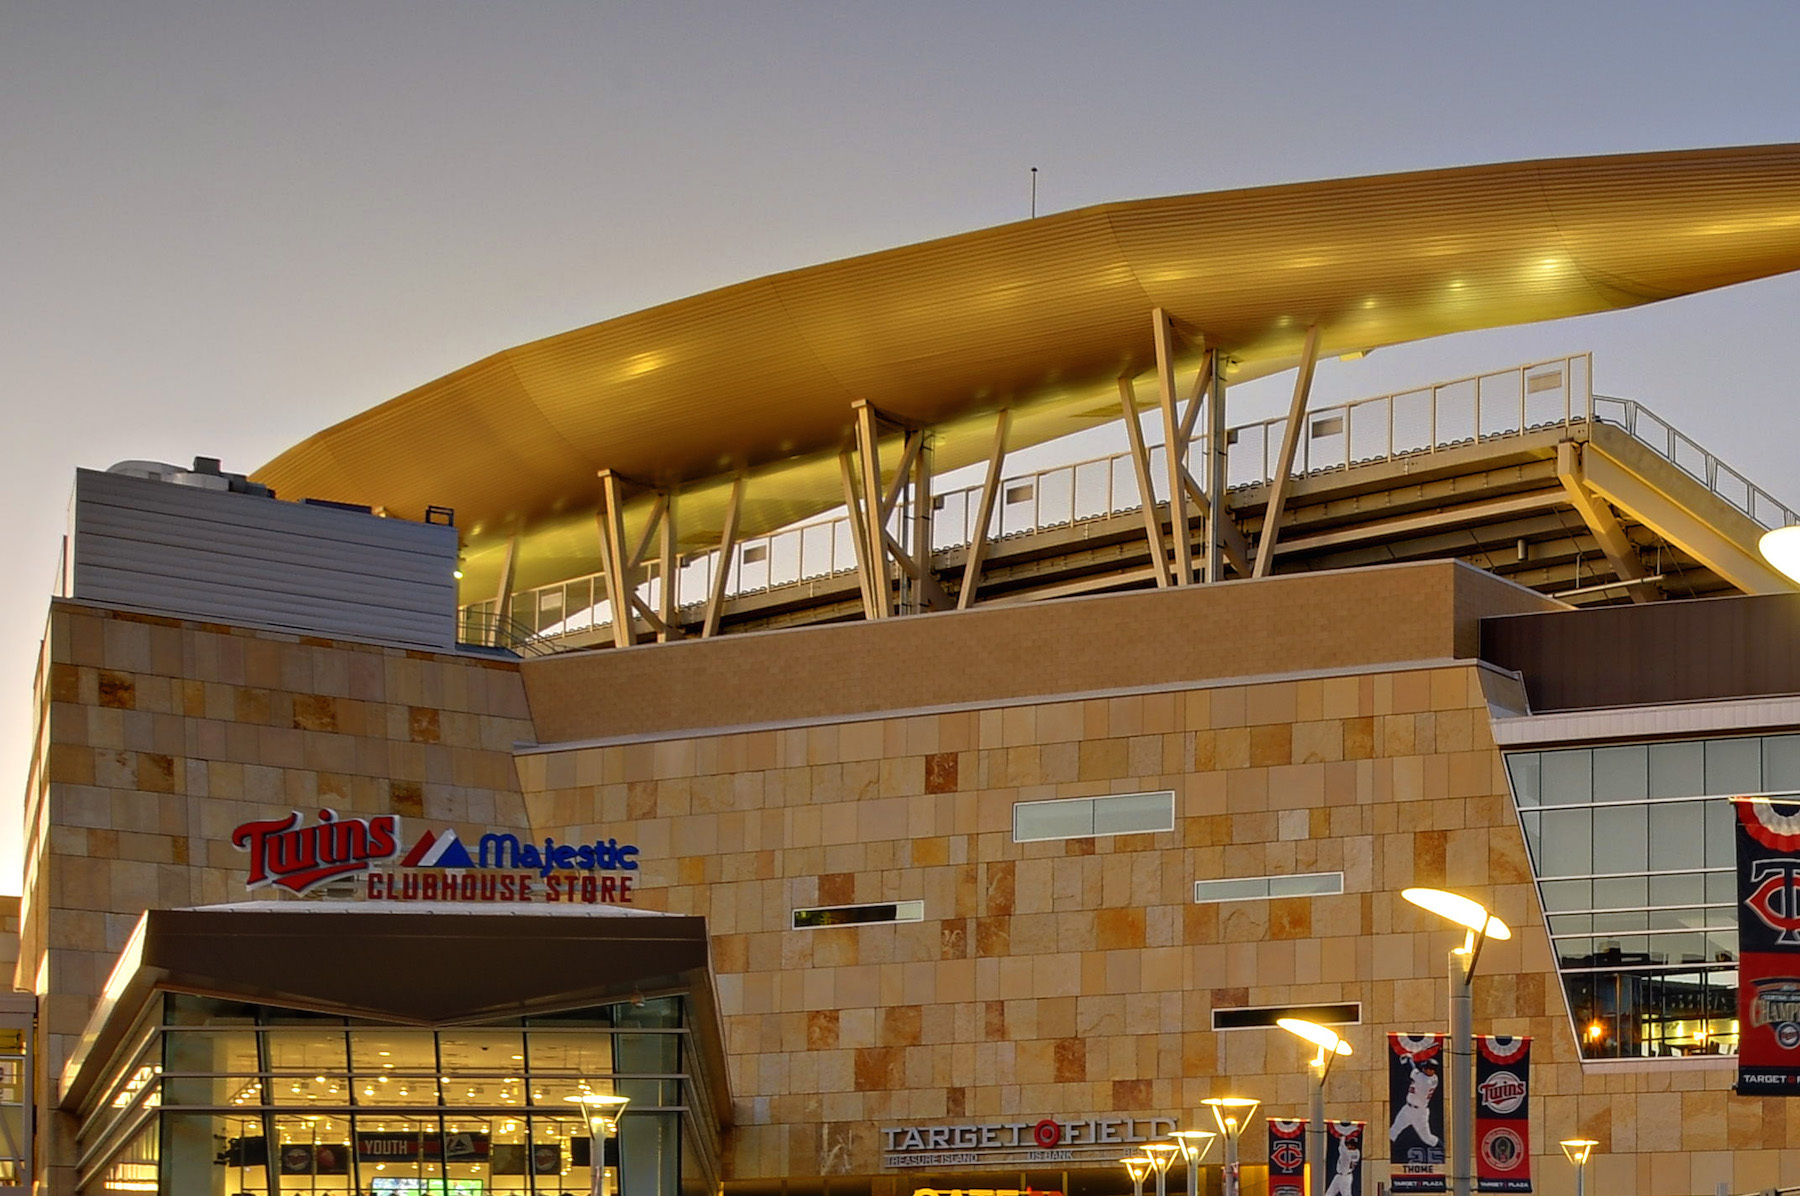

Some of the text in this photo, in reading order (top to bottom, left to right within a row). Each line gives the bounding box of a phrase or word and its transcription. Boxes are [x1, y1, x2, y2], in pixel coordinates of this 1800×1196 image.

[231, 808, 399, 895] Twins
[479, 833, 640, 878] Majestic
[368, 873, 634, 904] CLUBHOUSE STORE
[1743, 1074, 1787, 1084] TARGET
[1478, 1080, 1527, 1106] Twins
[881, 1117, 1178, 1150] TARGET FIELD
[364, 1139, 408, 1155] YOUTH
[1028, 1150, 1074, 1161] US BANK
[886, 1153, 979, 1166] TREASURE ISLAND
[1402, 1164, 1434, 1174] THOME
